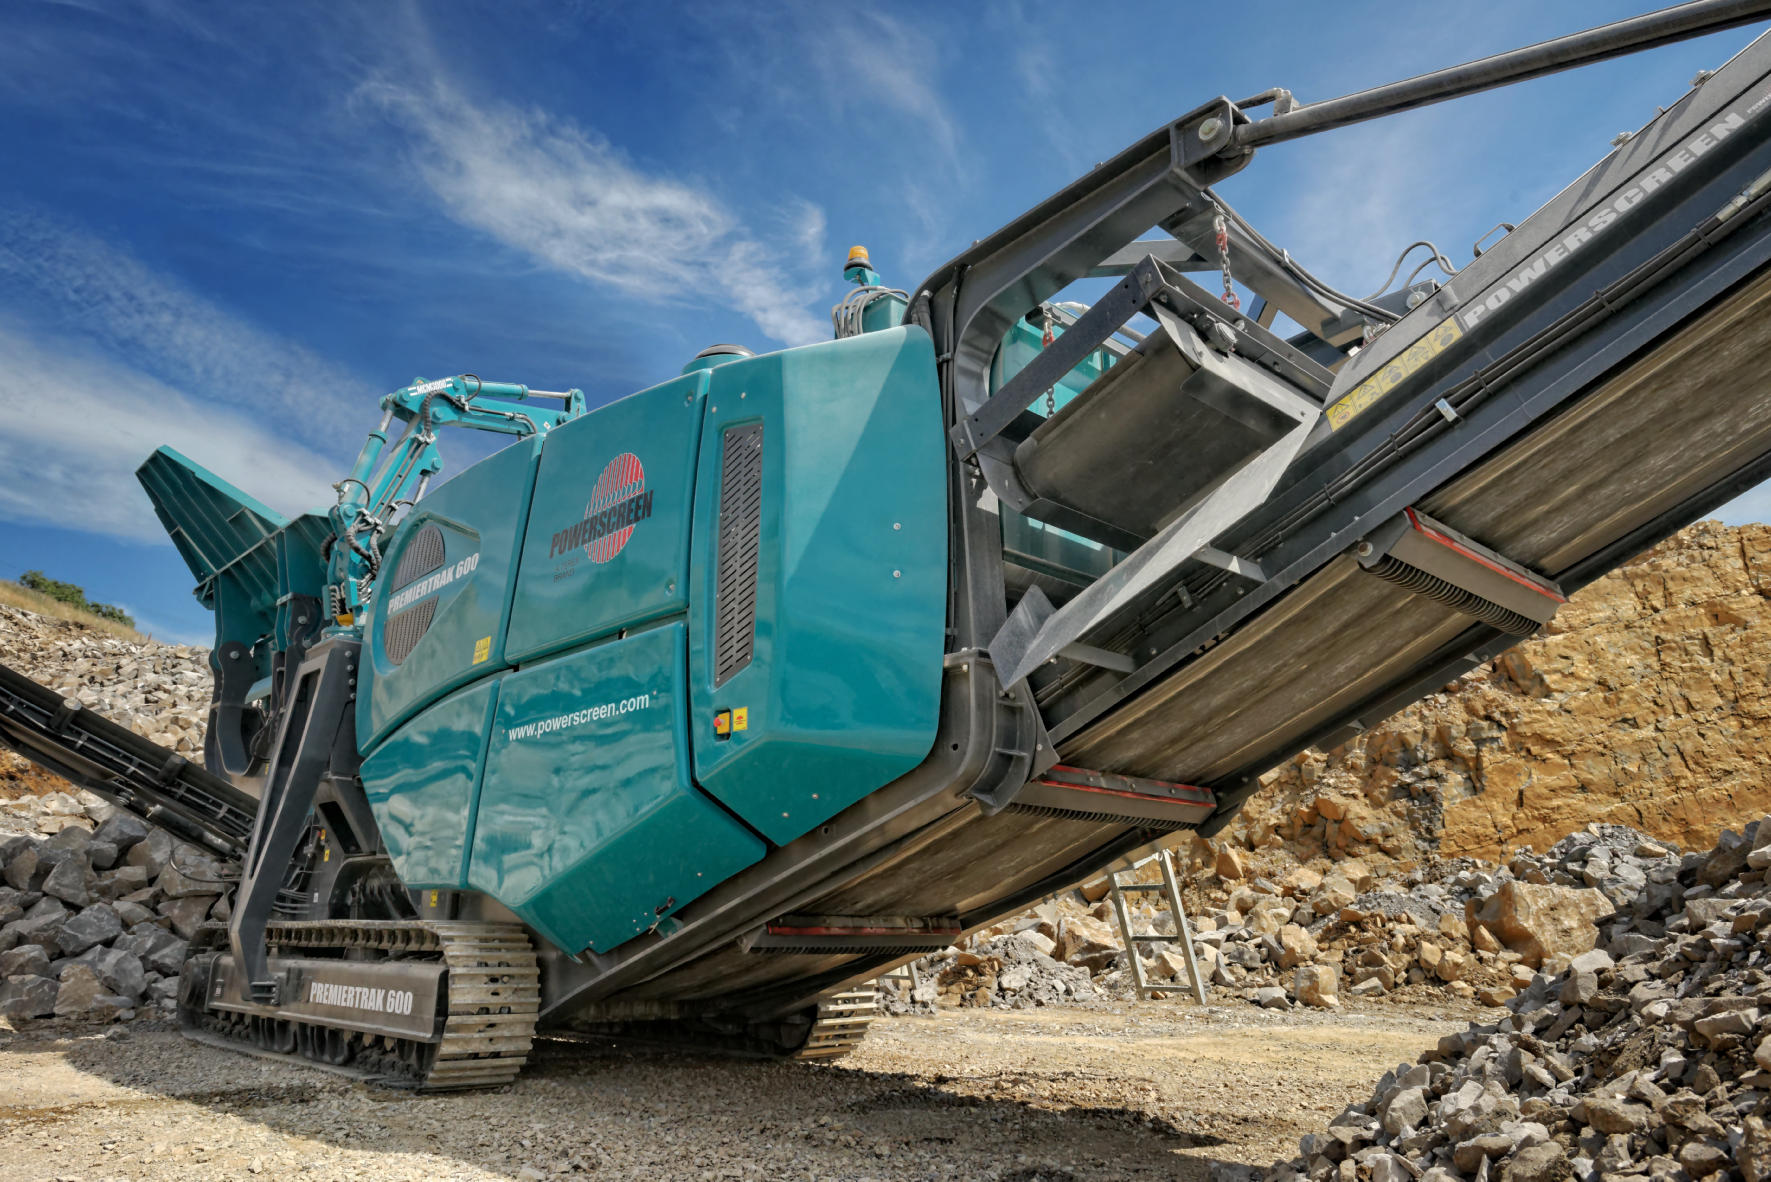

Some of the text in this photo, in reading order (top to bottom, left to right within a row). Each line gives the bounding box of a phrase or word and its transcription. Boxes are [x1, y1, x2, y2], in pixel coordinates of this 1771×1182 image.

[1462, 112, 1745, 329] POWERSCREEN
[549, 489, 654, 559] POWERSCREEN
[387, 552, 480, 615] PREMIERTRAK 600
[508, 694, 650, 741] www.powerscreen.com
[309, 981, 414, 1015] PREMIERTRAK 600
